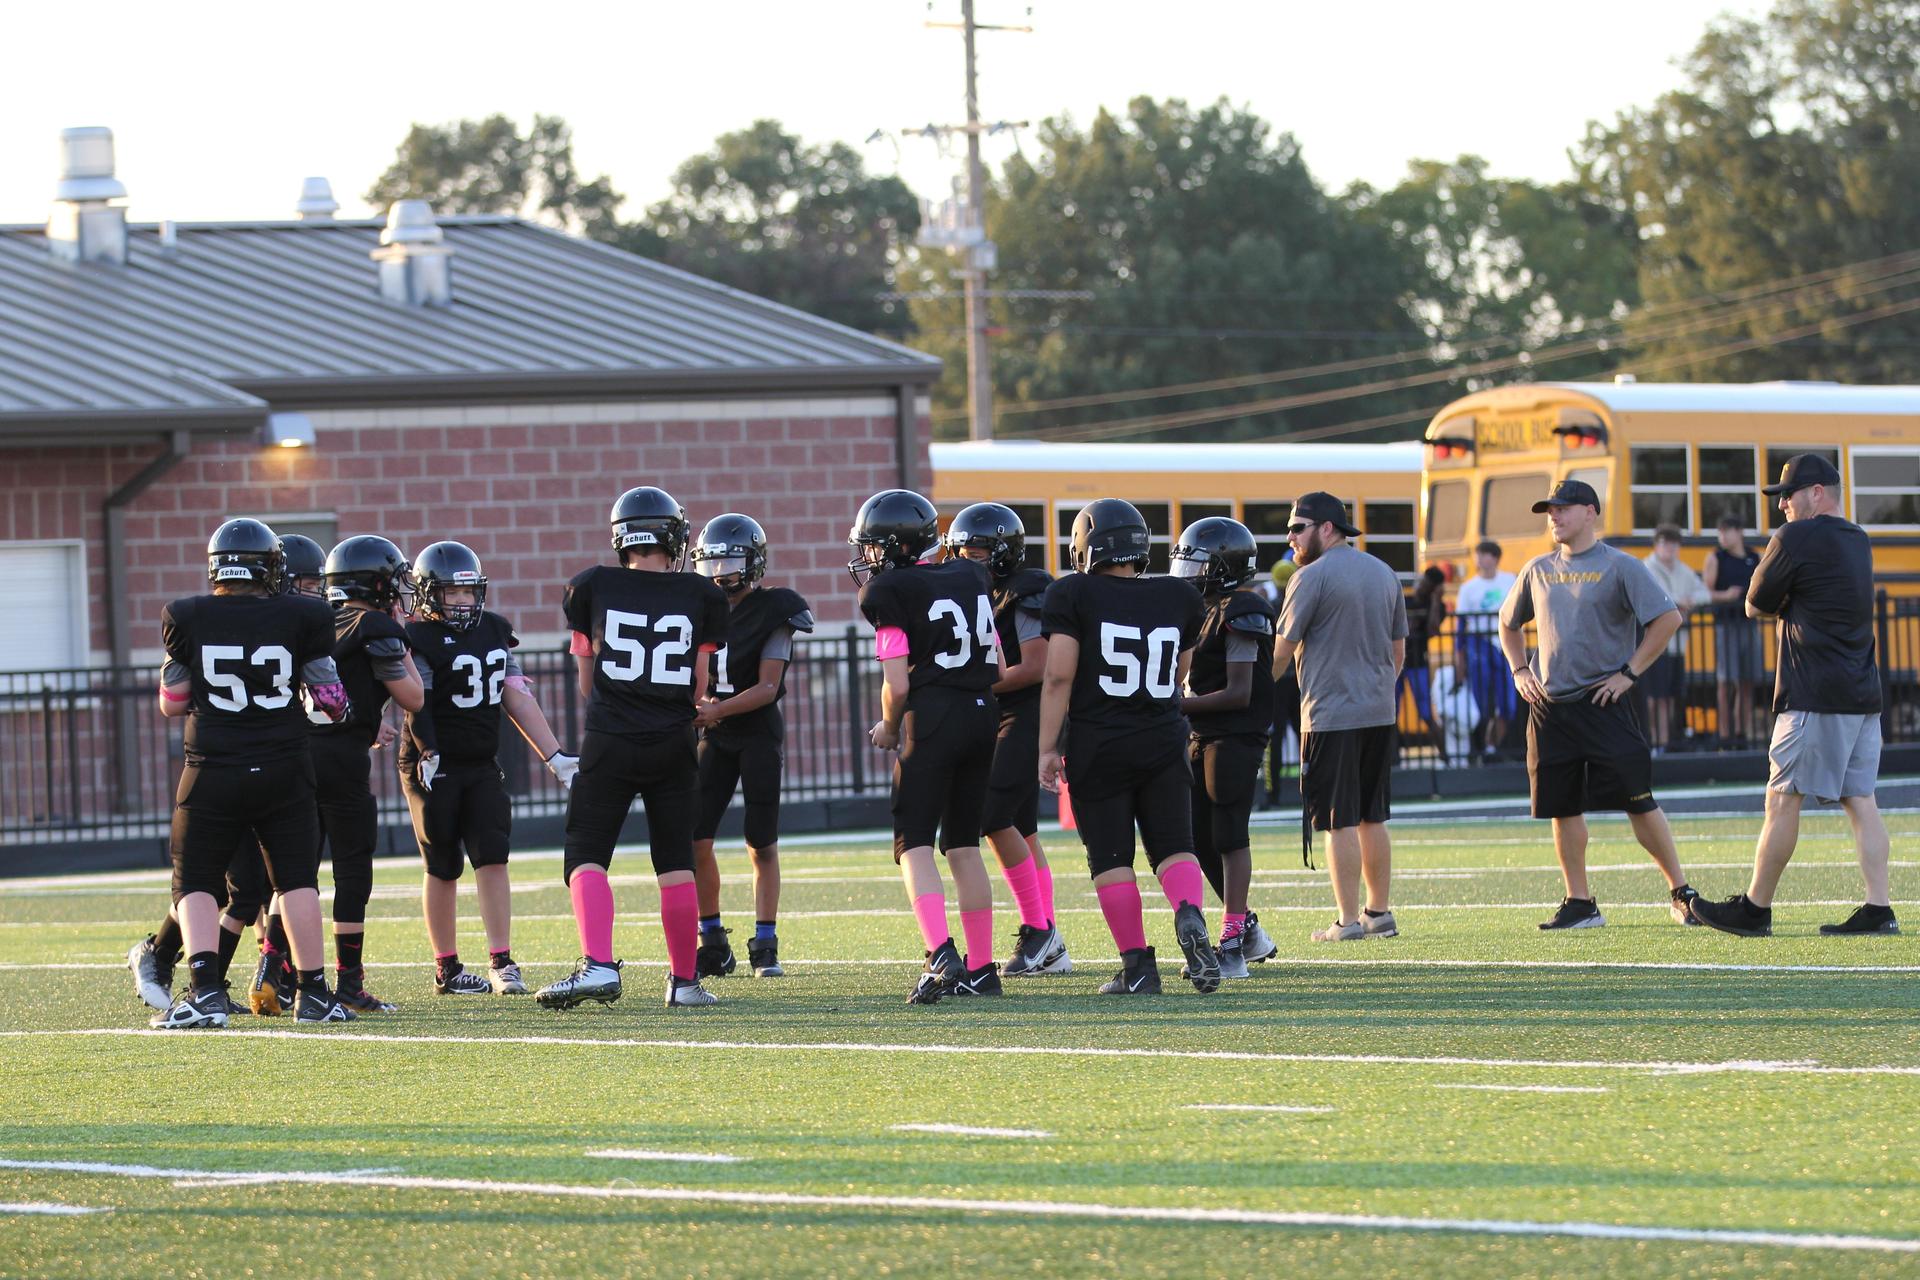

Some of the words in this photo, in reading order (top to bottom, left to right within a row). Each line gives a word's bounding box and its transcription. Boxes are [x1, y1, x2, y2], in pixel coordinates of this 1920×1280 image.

[1481, 422, 1525, 449] SCHOOL
[625, 534, 652, 543] schutt
[220, 569, 247, 577] schutt
[602, 609, 693, 686] 52
[927, 594, 999, 669] 34
[1099, 622, 1180, 698] 50
[201, 645, 293, 712] 53
[451, 648, 507, 708] 32
